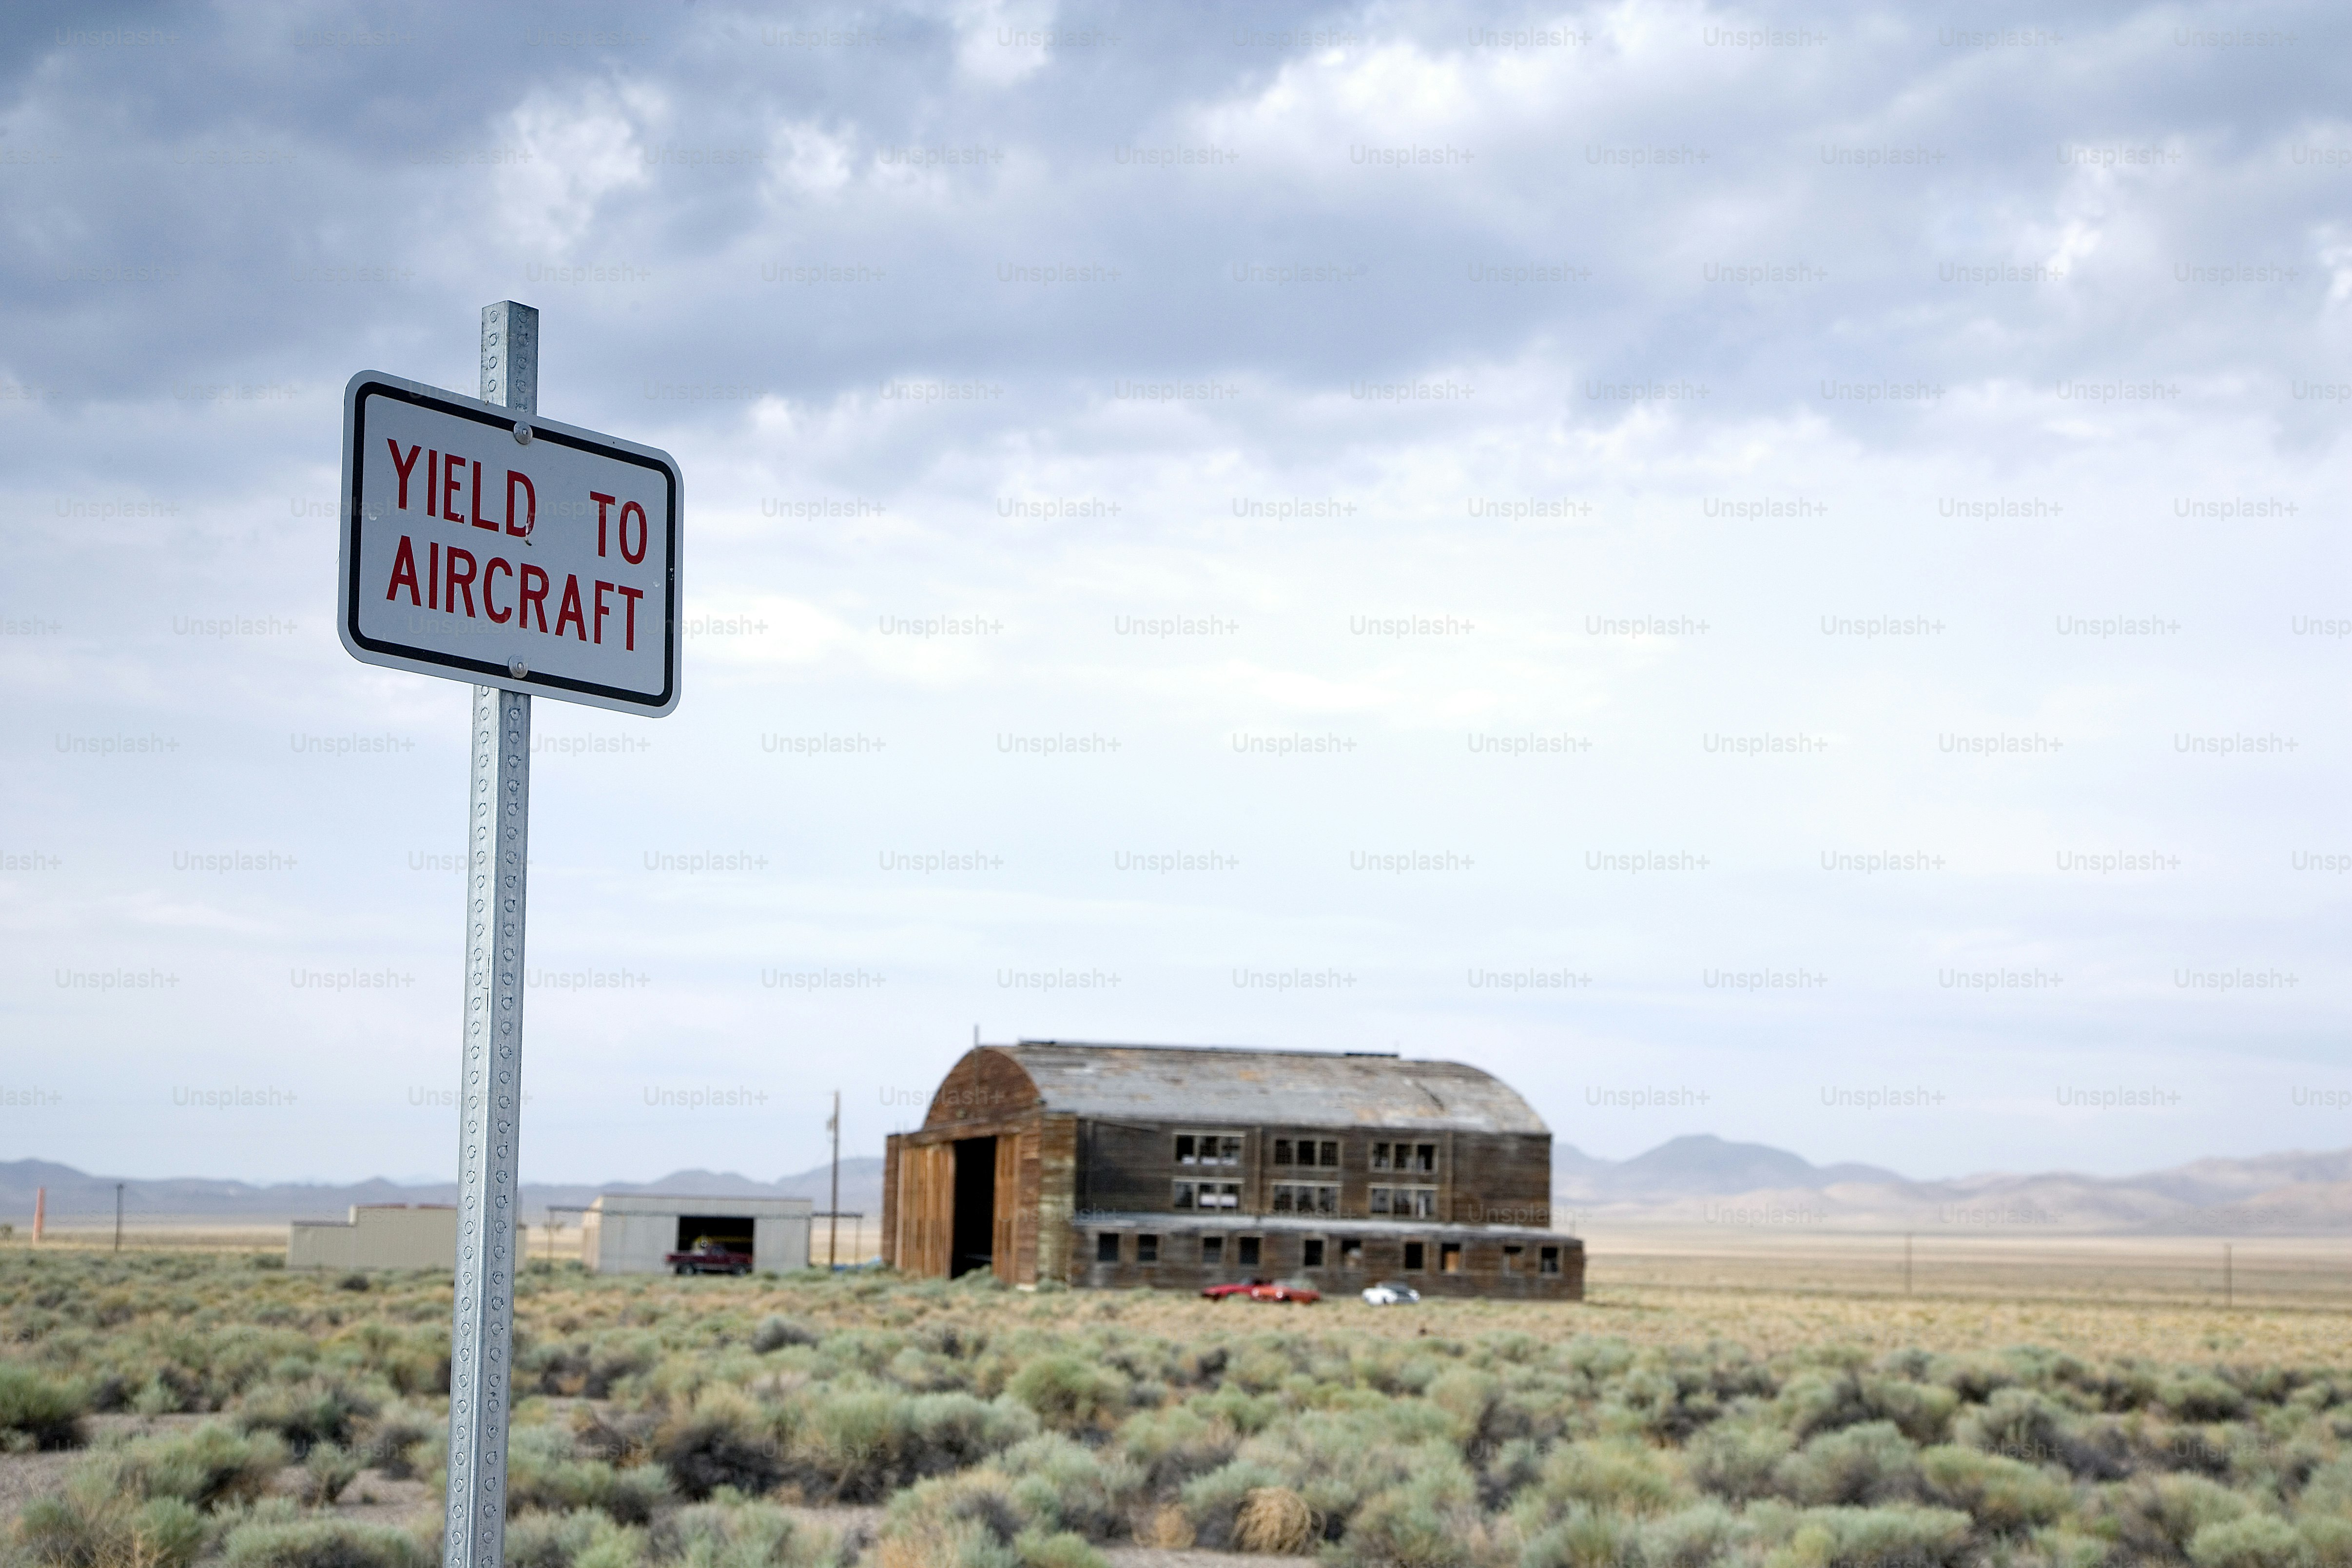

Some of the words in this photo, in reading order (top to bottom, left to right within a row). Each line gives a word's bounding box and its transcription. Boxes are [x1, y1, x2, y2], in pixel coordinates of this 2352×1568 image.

[387, 439, 536, 538] YIELD
[590, 491, 647, 564] TO
[386, 535, 643, 652] AIRCRAFT
